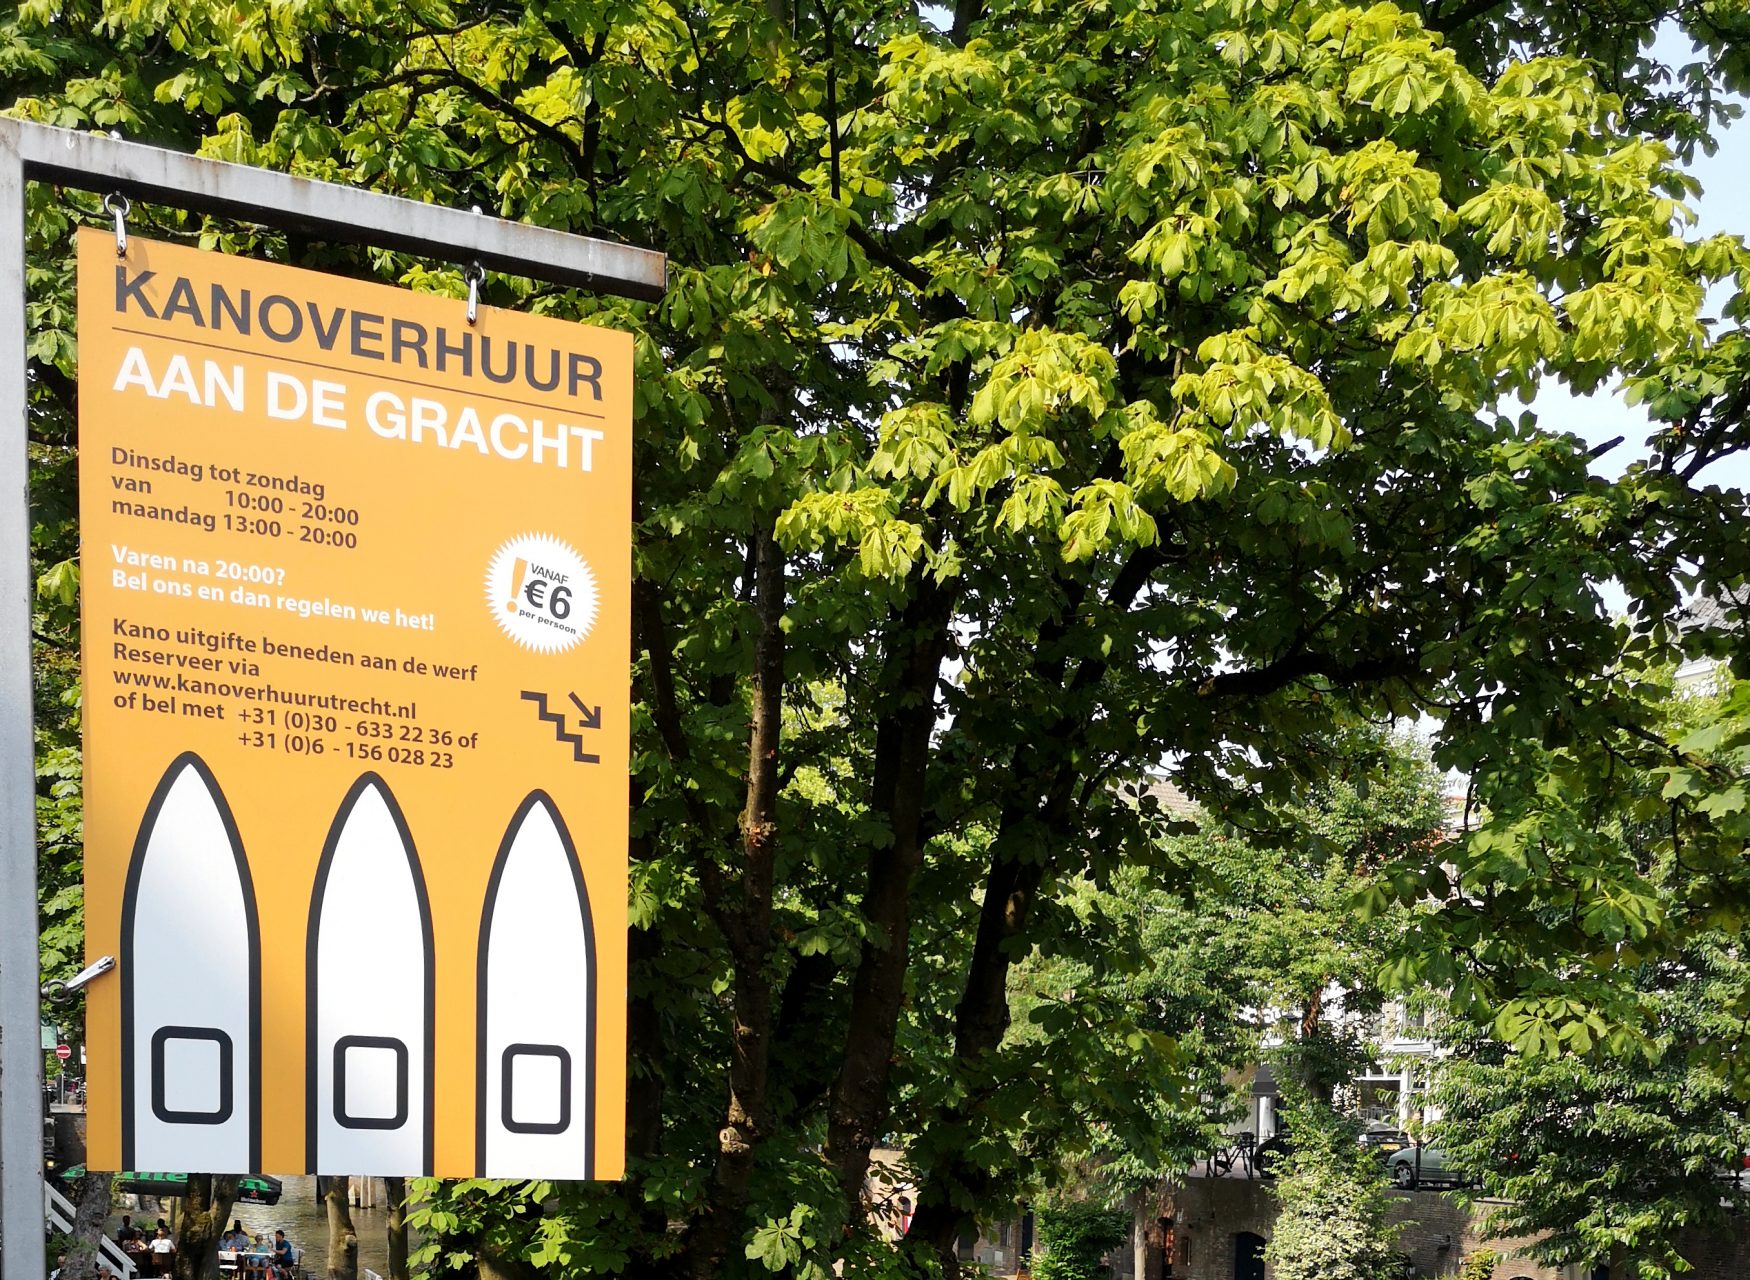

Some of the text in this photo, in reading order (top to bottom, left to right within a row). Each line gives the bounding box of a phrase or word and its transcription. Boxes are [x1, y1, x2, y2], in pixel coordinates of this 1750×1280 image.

[115, 265, 603, 402] KANOVERHUUR
[112, 347, 604, 472] AAN DE GRACHT
[111, 447, 325, 501] Dinsdag tot zondag
[111, 476, 152, 493] van
[225, 490, 283, 514] 10:00
[301, 502, 359, 526] 20:00
[112, 500, 216, 532] maandag
[223, 514, 282, 537] 13:00
[300, 525, 357, 549] 20:00
[111, 544, 286, 586] Varen na 20:00?
[531, 563, 569, 584] VANAF
[112, 569, 434, 631] Bel ons en dan regelen we het!
[519, 609, 576, 635] per persoon
[524, 579, 573, 620] €6
[113, 618, 478, 681] Kano uitgifte beneden aan de werf
[113, 642, 260, 677] Reserveer via
[113, 670, 416, 719] www.kanoverhuurutrecht.nl
[113, 692, 137, 709] of
[142, 693, 176, 714] bel
[182, 702, 225, 720] met
[238, 707, 275, 726] +31
[284, 710, 337, 733] (0)30
[356, 720, 393, 739] 633
[399, 725, 423, 743] 22
[428, 728, 453, 746] 36
[457, 732, 478, 749] of
[238, 731, 275, 749] +31
[284, 733, 324, 756] (0)6
[346, 741, 382, 761] 156
[388, 746, 425, 766] 028
[430, 751, 453, 769] 23
